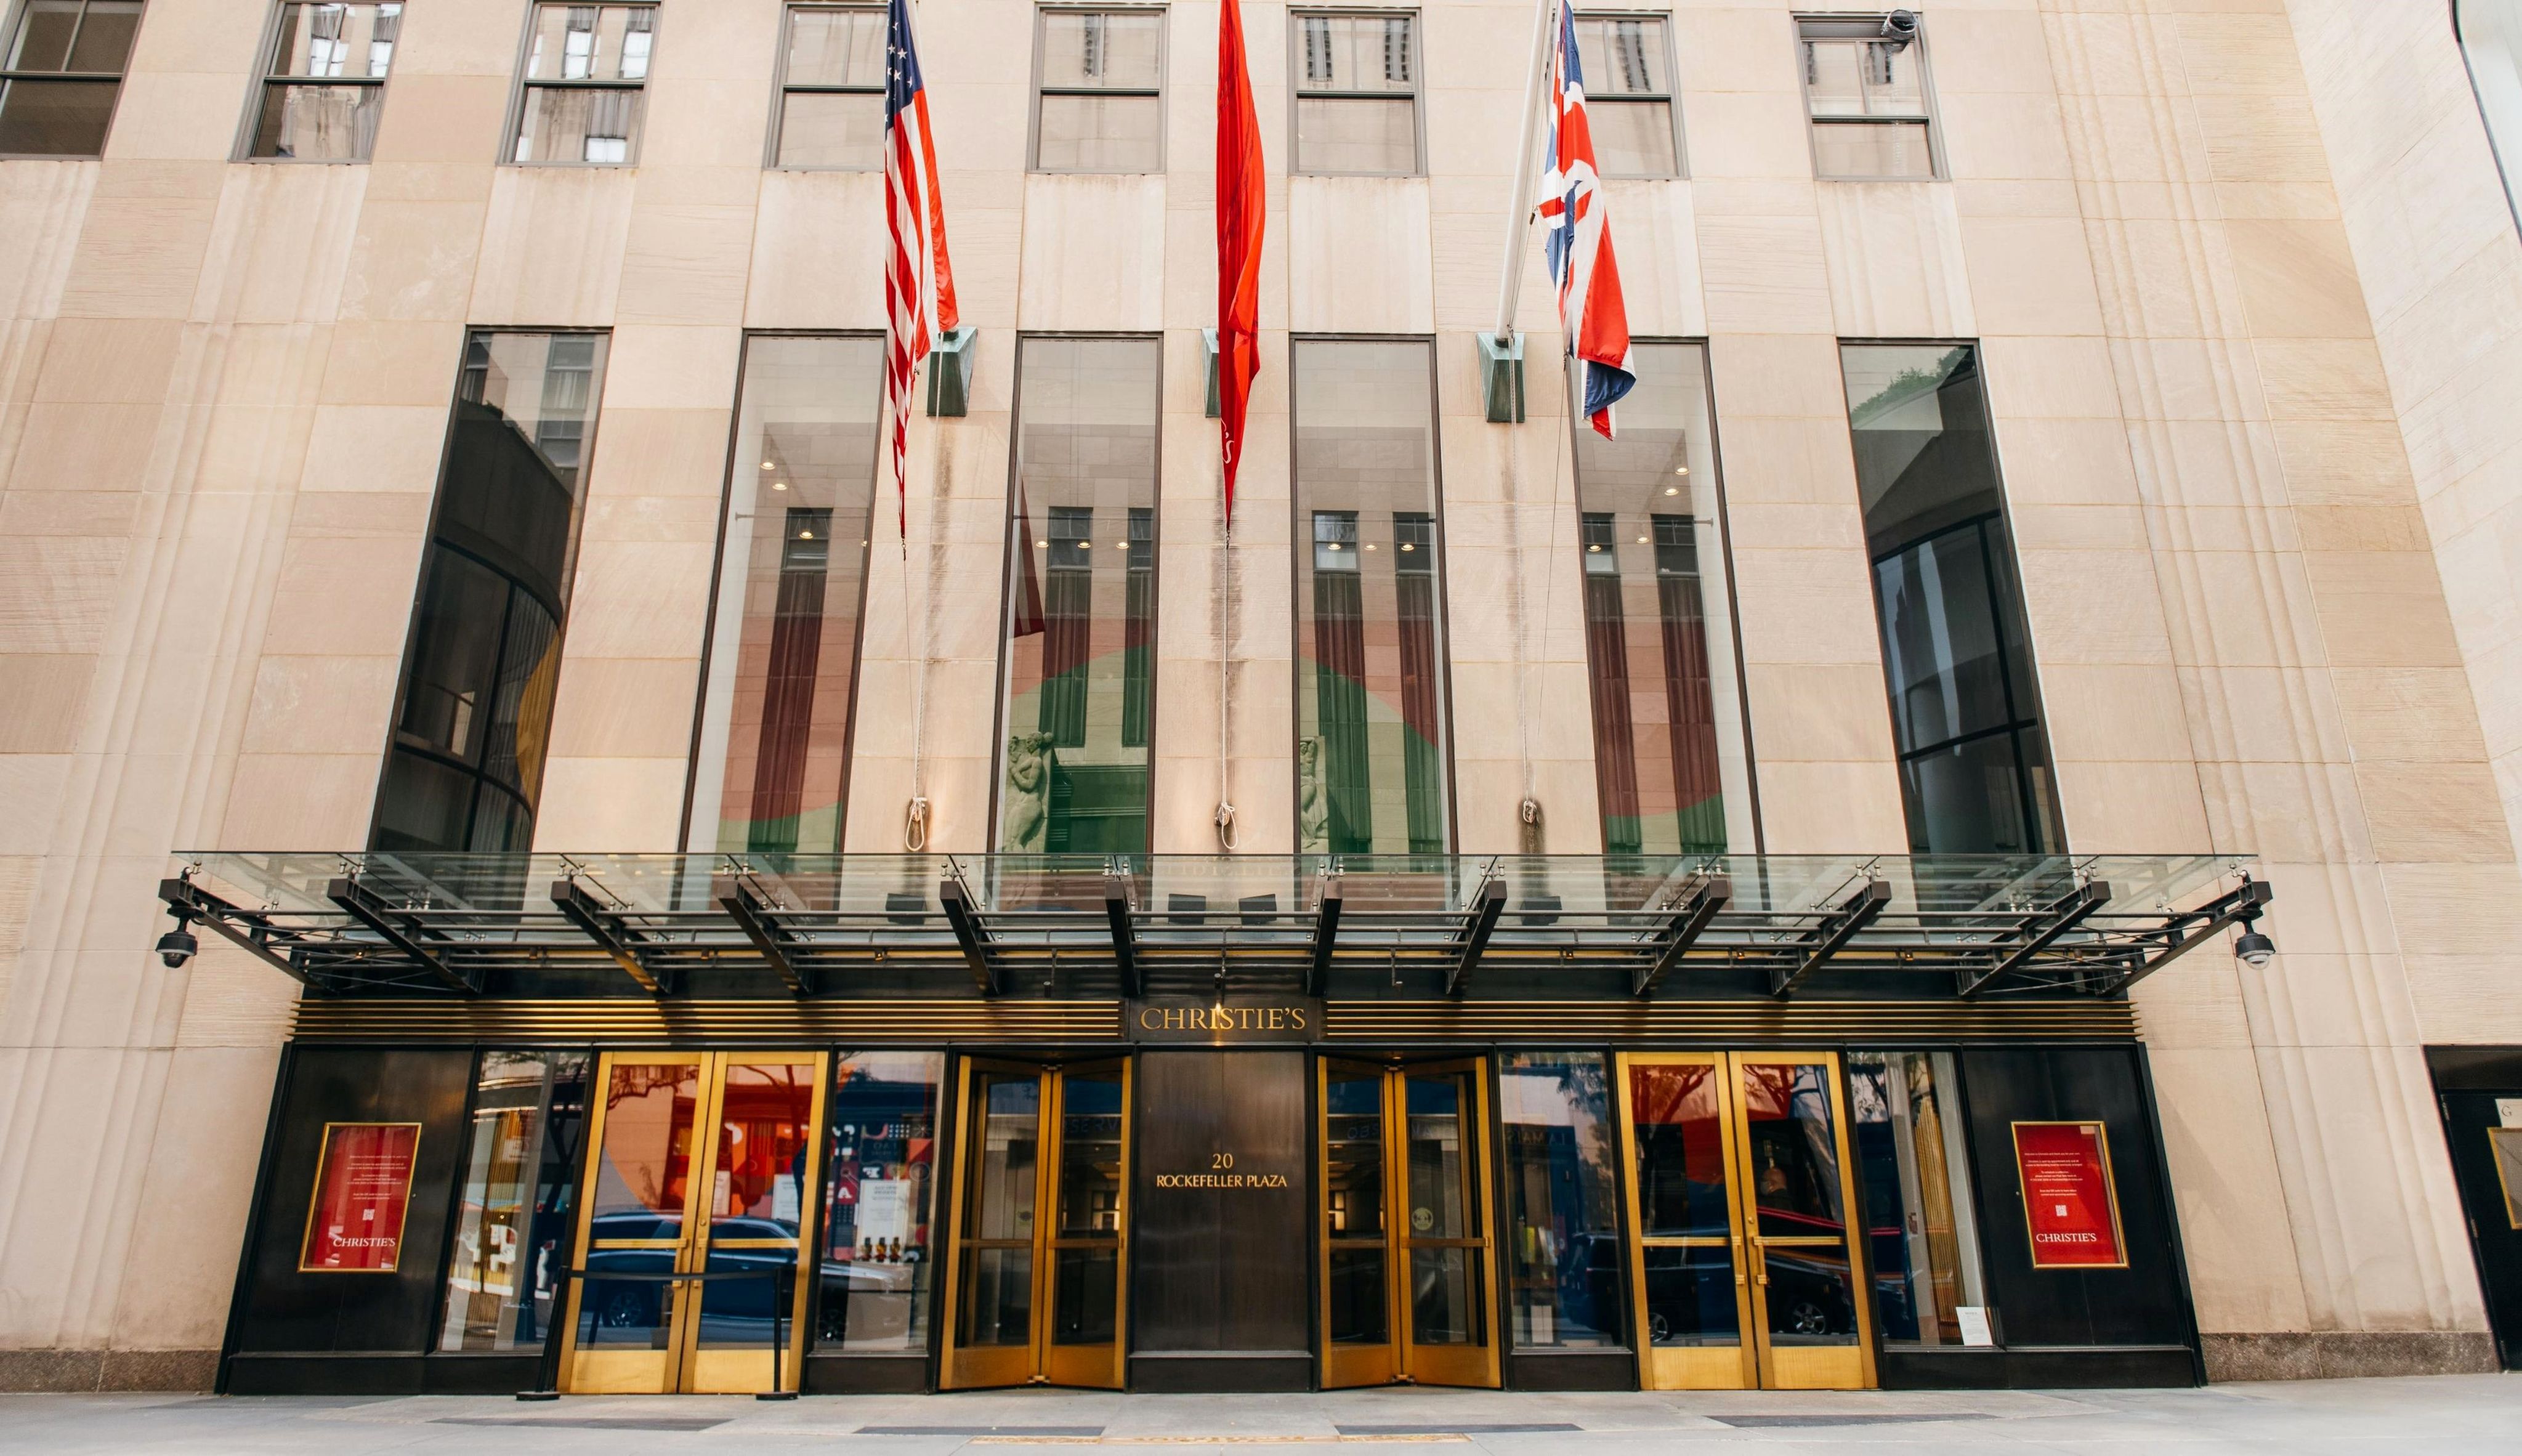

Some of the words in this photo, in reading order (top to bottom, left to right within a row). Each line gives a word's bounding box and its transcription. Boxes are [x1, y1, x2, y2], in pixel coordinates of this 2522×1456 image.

[1141, 1007, 1306, 1030] CHRISTIE'S
[1212, 1153, 1233, 1169] 20
[1156, 1175, 1242, 1187] ROCKEFELLER
[1247, 1175, 1287, 1187] PLAZA
[333, 1237, 396, 1247] CHRISTIE'S
[2036, 1232, 2097, 1243] CHRISTIE'S
